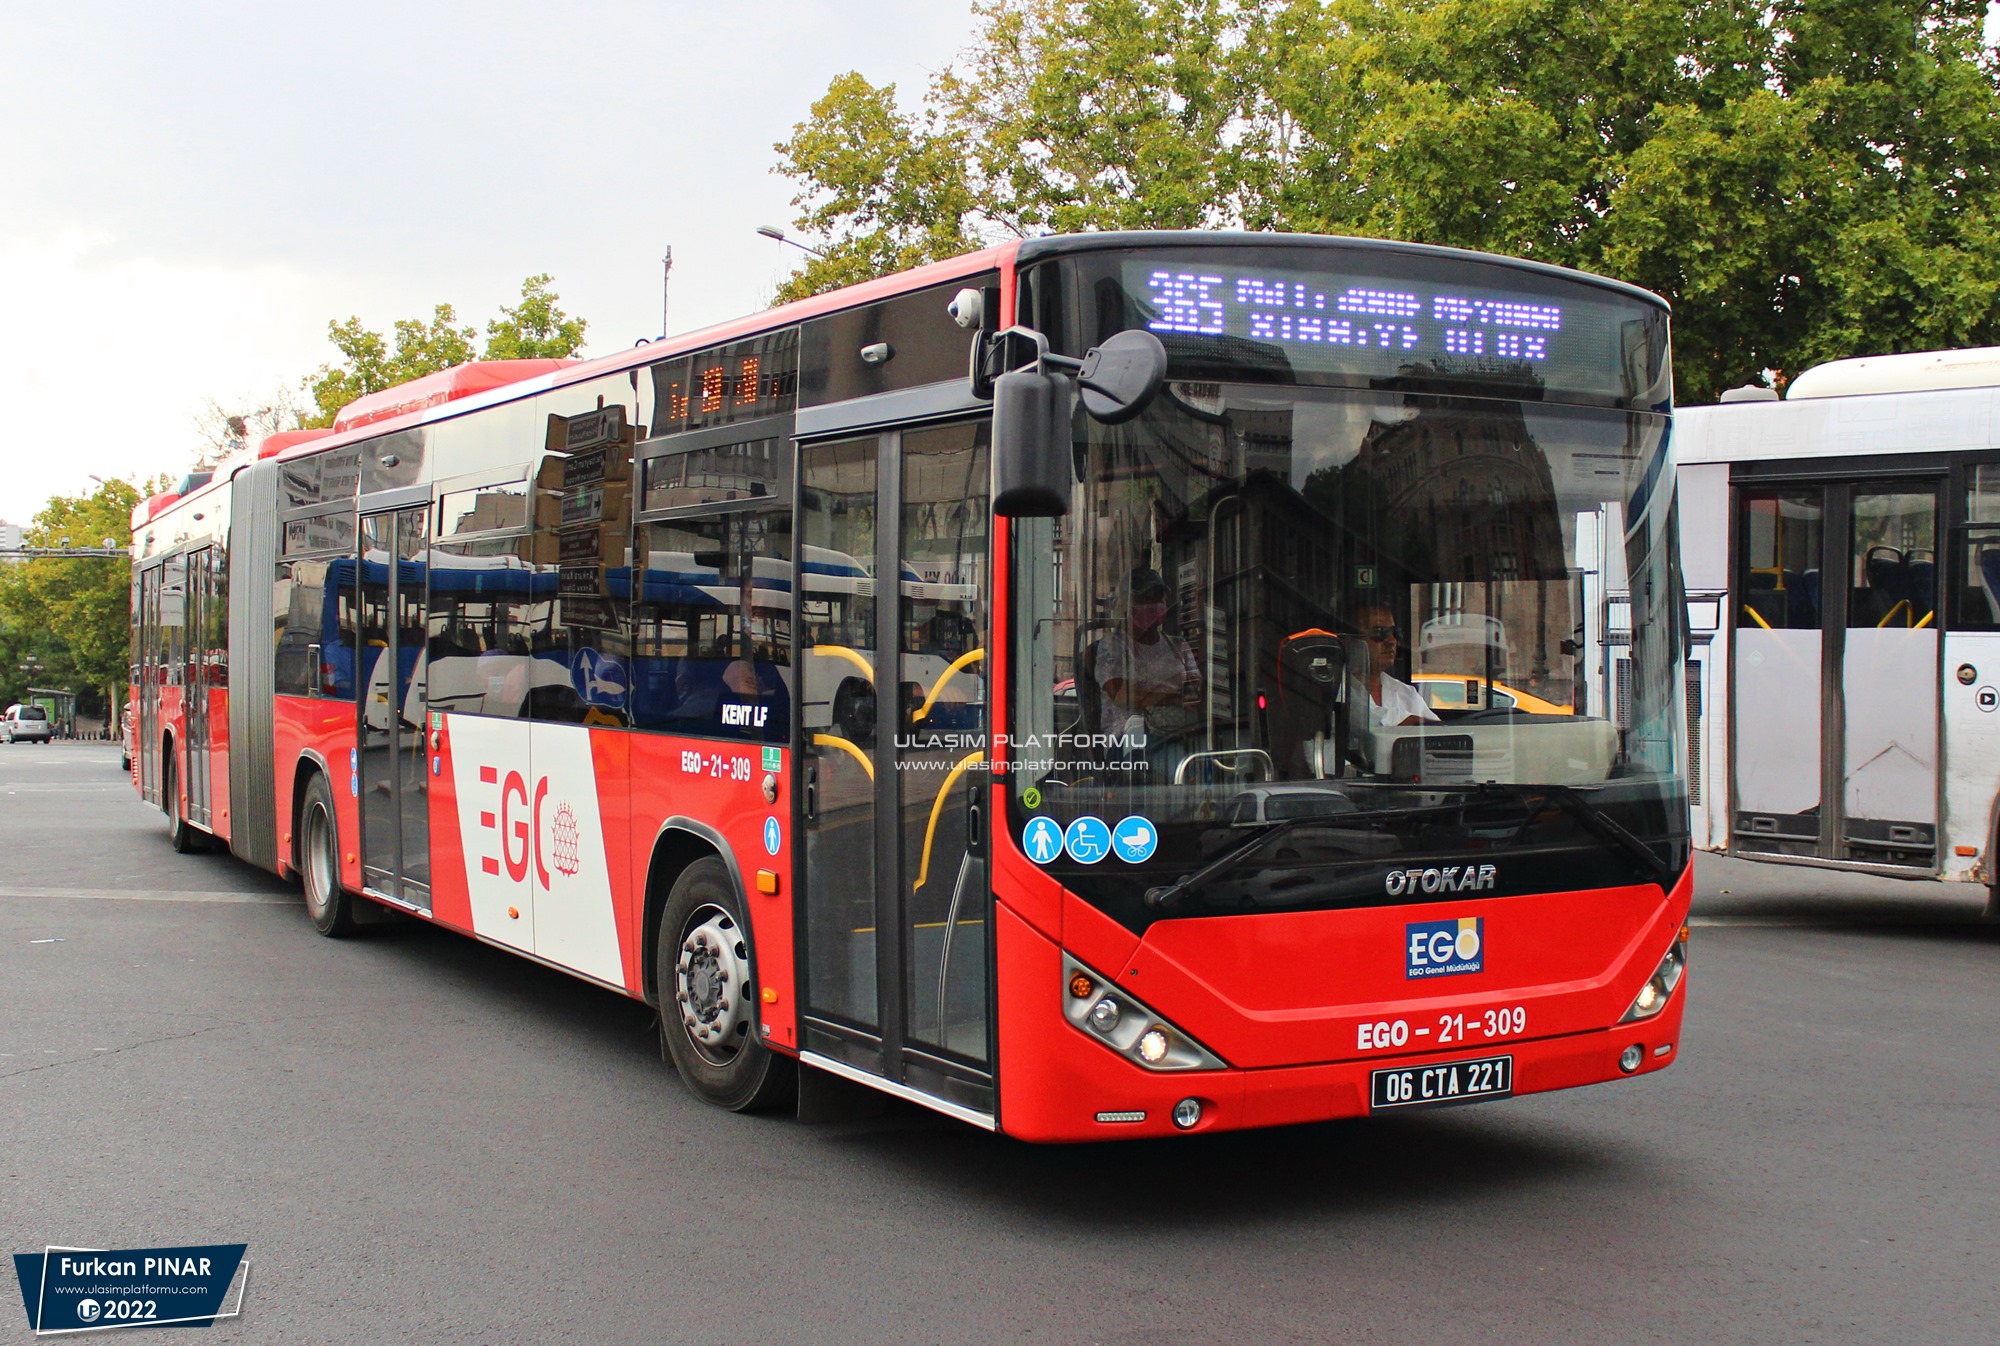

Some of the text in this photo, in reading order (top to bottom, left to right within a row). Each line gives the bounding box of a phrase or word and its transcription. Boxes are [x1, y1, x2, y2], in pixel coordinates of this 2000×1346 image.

[1148, 271, 1223, 334] 365
[721, 703, 768, 727] KENT LF
[1385, 864, 1497, 896] OTOKAR
[1409, 929, 1480, 966] EGO
[1409, 967, 1424, 976] EGO
[1425, 964, 1446, 975] Genel
[1357, 1019, 1409, 1050] EGO
[1386, 1061, 1504, 1103] 06 CTA 221
